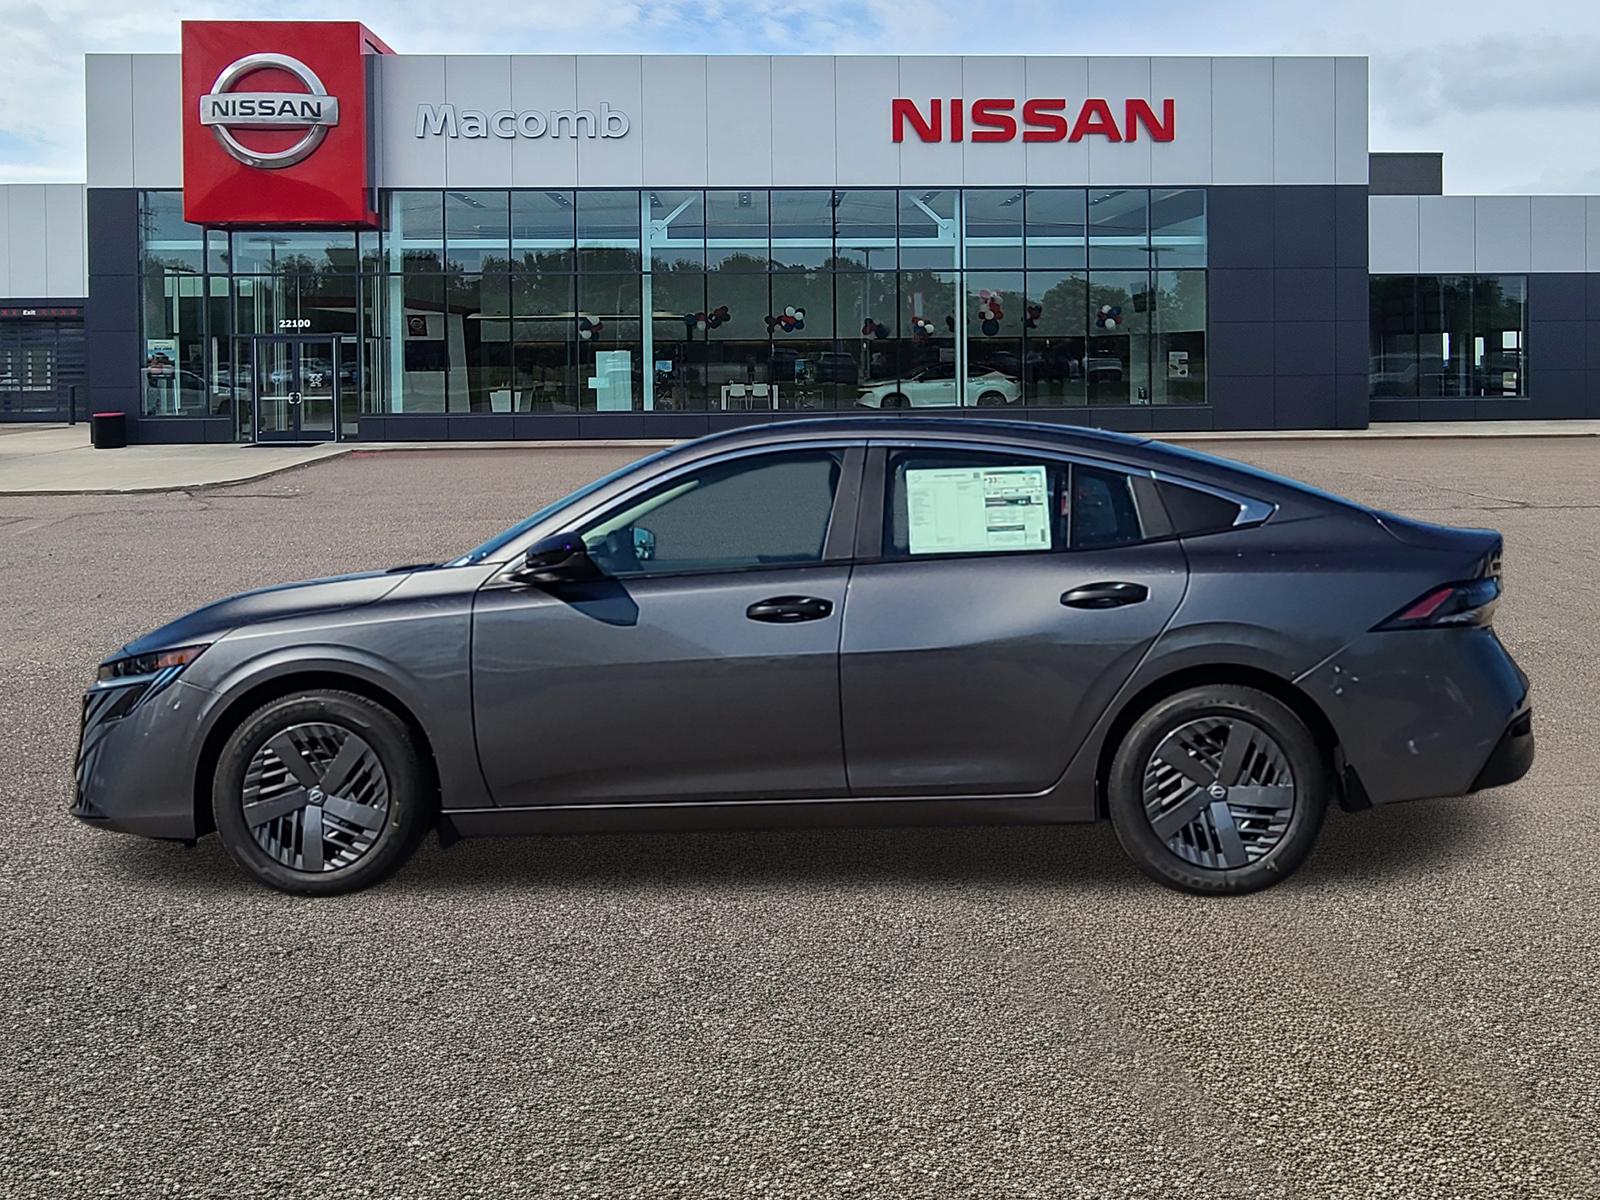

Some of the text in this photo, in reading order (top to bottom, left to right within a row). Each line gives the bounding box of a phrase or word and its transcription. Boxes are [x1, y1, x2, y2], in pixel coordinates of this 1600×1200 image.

[212, 100, 322, 117] NISSAN
[415, 102, 630, 139] Macomb
[892, 98, 1175, 143] NISSAN
[279, 319, 311, 328] 22100
